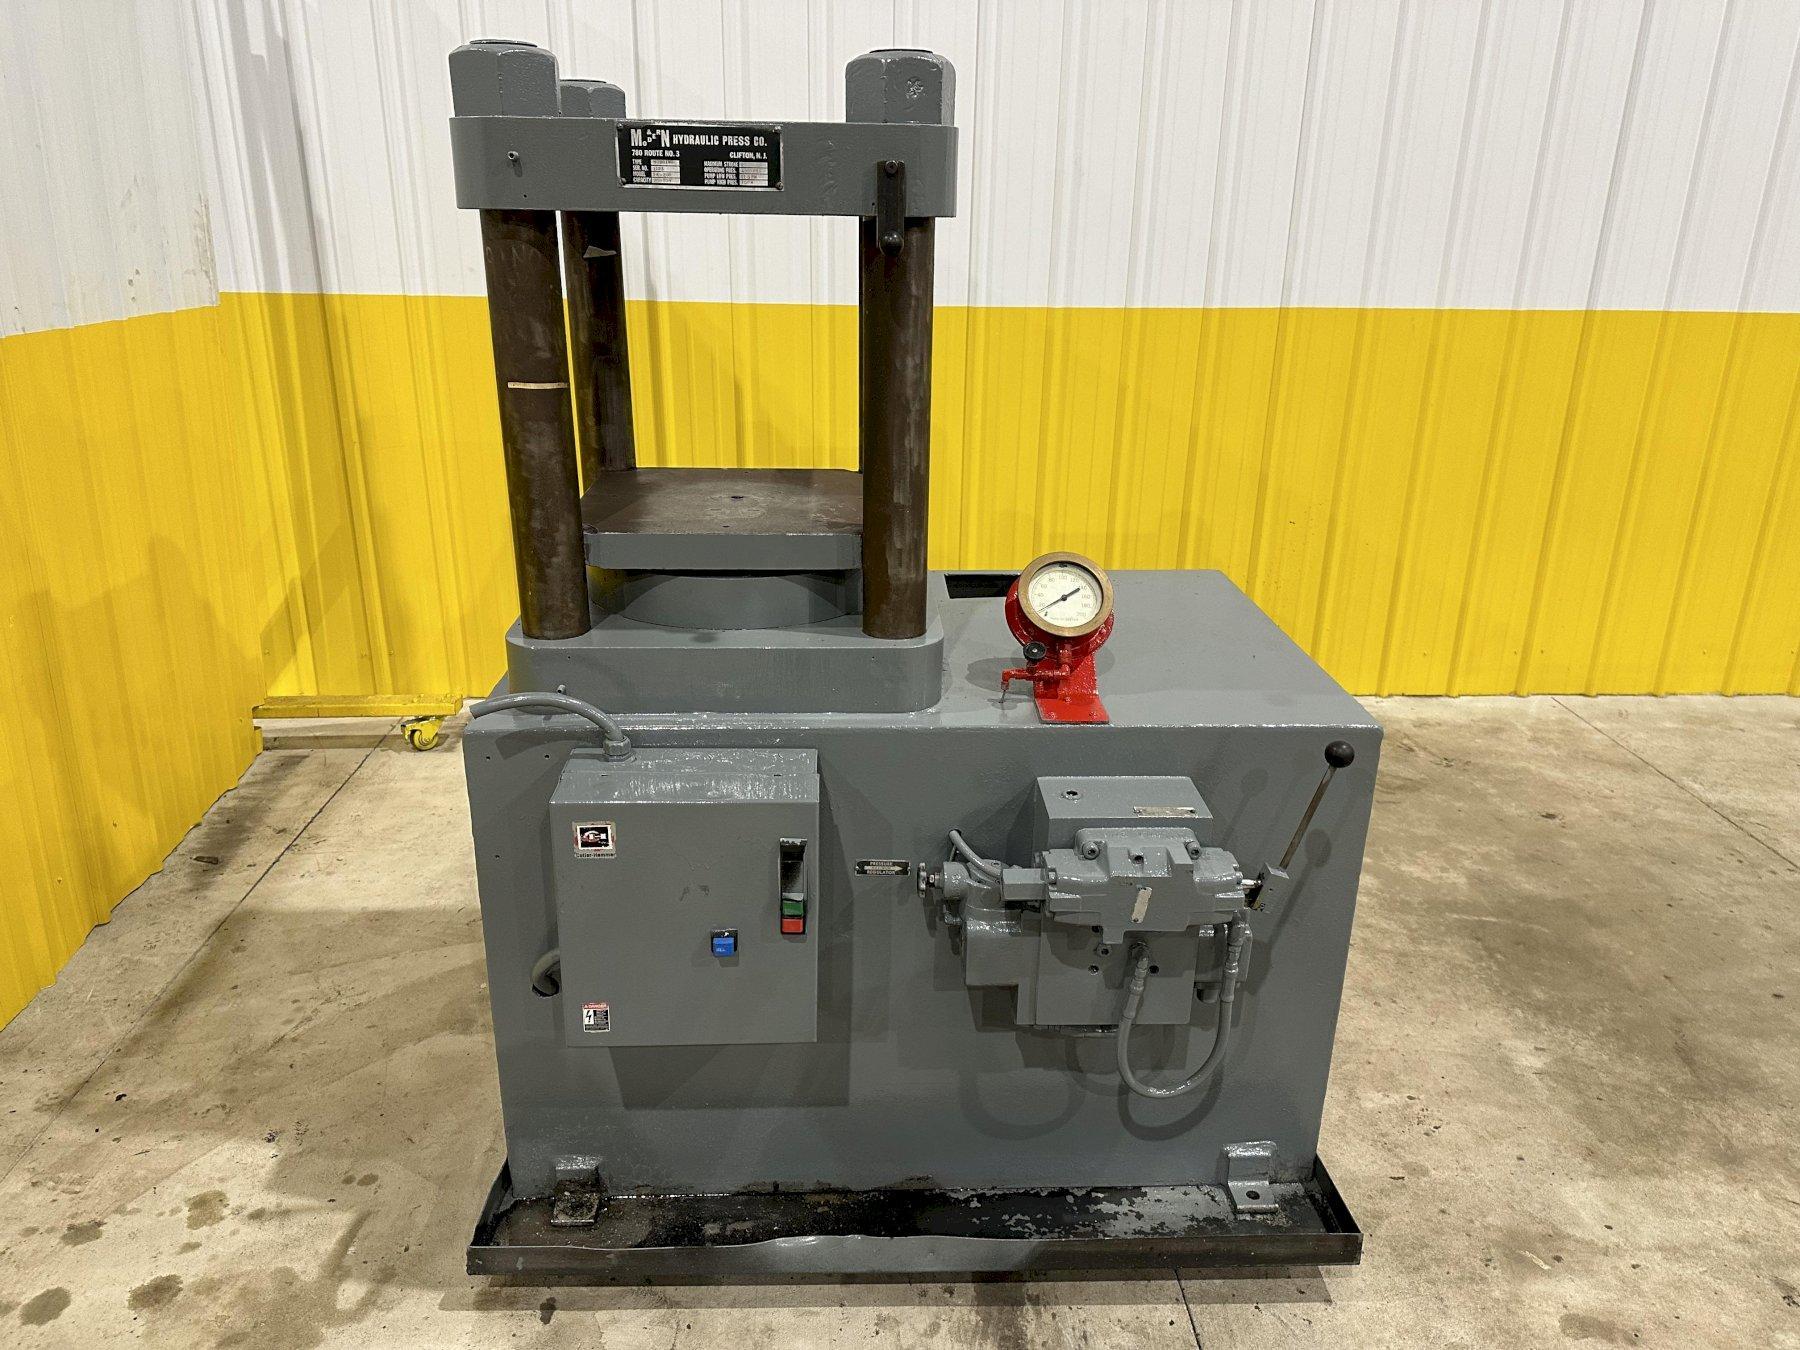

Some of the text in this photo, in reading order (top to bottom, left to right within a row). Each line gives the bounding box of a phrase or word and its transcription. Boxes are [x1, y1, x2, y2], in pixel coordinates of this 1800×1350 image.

[672, 134, 719, 145] HYDRAULIC
[722, 135, 750, 146] PRESS
[754, 136, 768, 146] CO.
